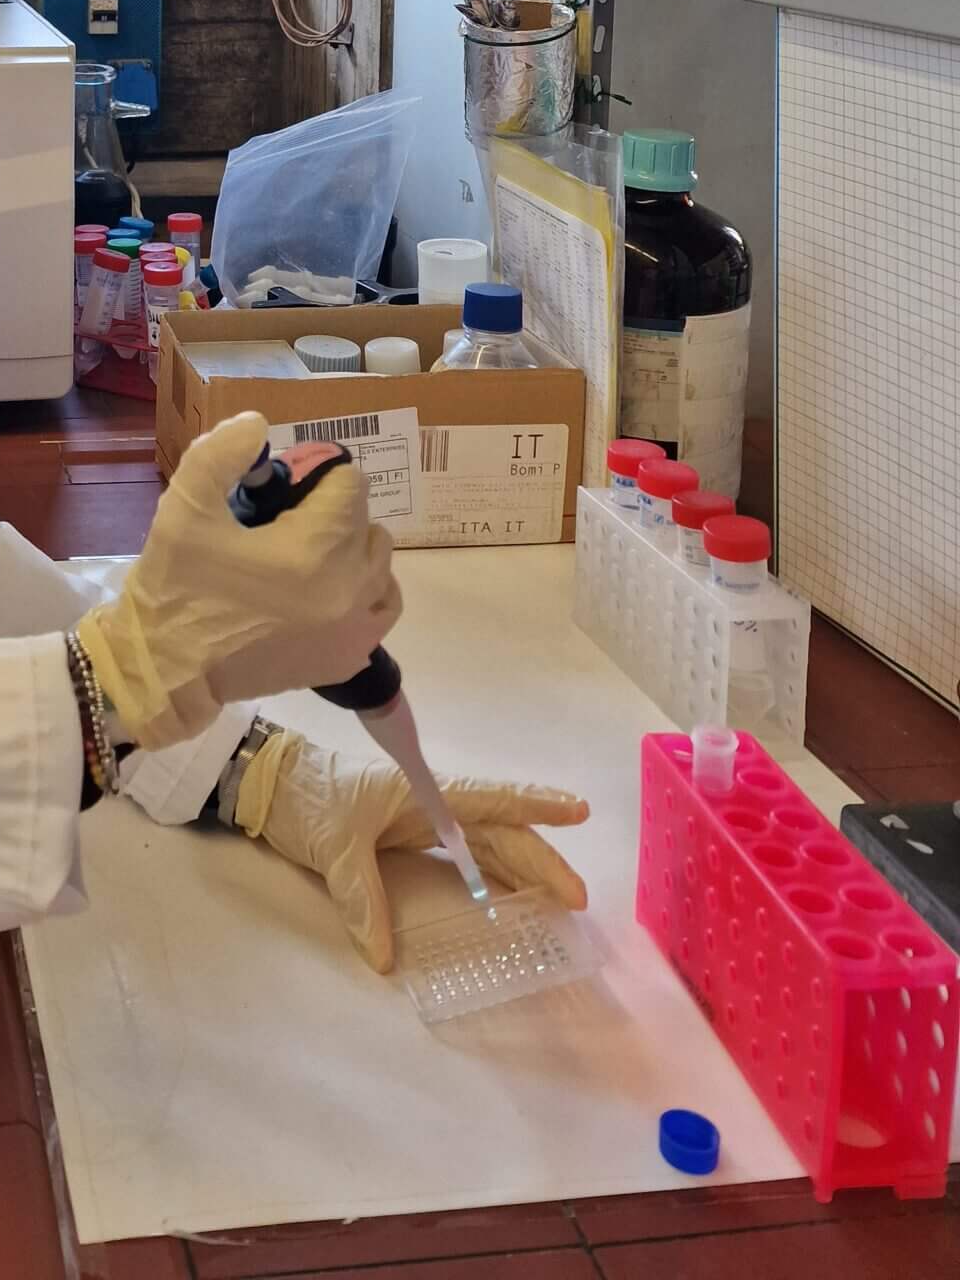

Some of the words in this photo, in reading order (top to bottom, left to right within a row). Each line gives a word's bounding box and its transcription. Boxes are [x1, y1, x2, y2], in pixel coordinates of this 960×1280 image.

[511, 434, 544, 459] IT
[510, 463, 543, 476] Bomi
[553, 463, 561, 475] P
[460, 521, 492, 534] ITA
[504, 520, 526, 533] IT
